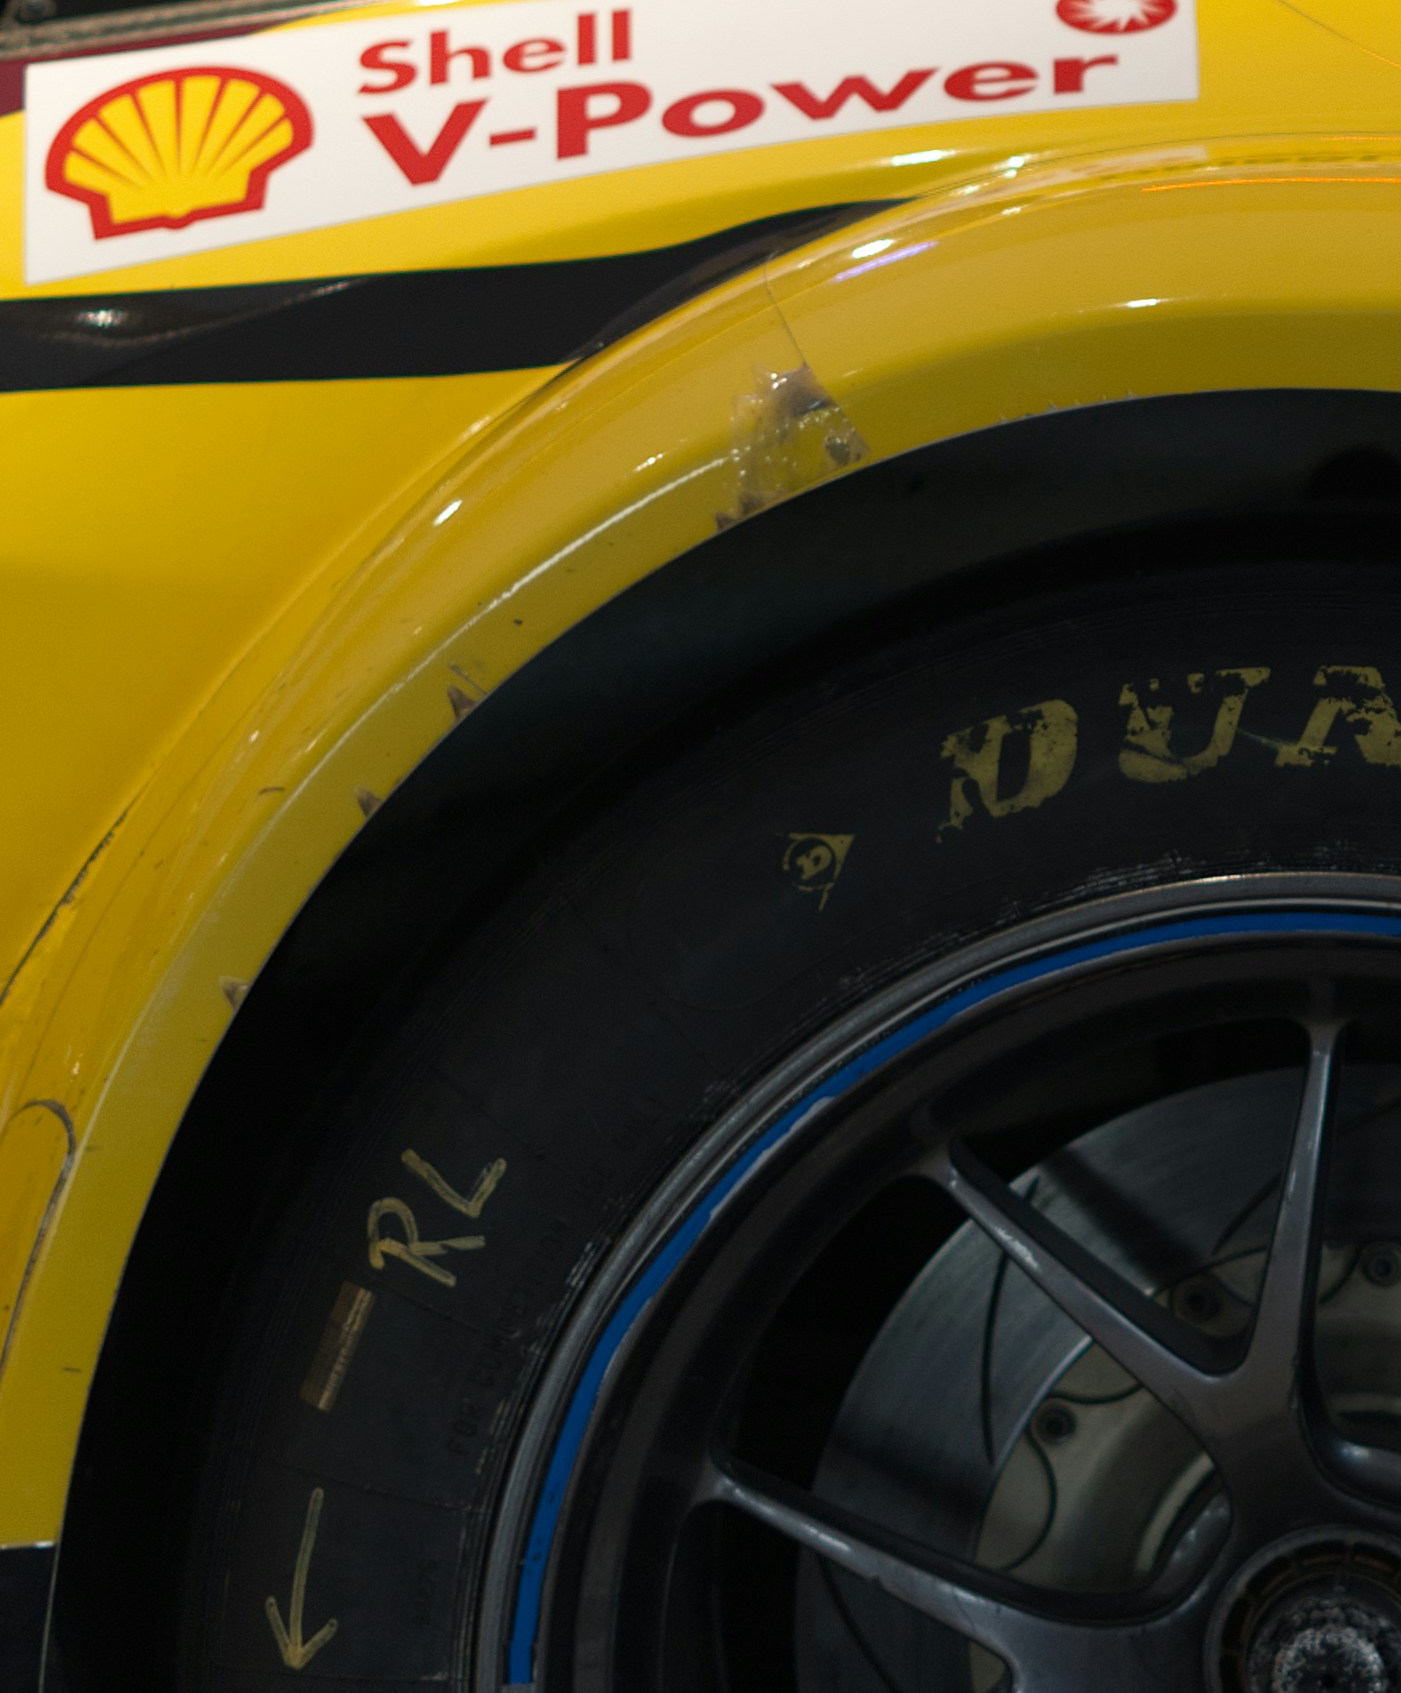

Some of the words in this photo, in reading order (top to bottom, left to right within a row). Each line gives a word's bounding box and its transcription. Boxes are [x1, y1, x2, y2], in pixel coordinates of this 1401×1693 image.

[357, 9, 632, 96] Shell
[362, 53, 1119, 187] V-Power
[367, 1147, 507, 1288] RL
